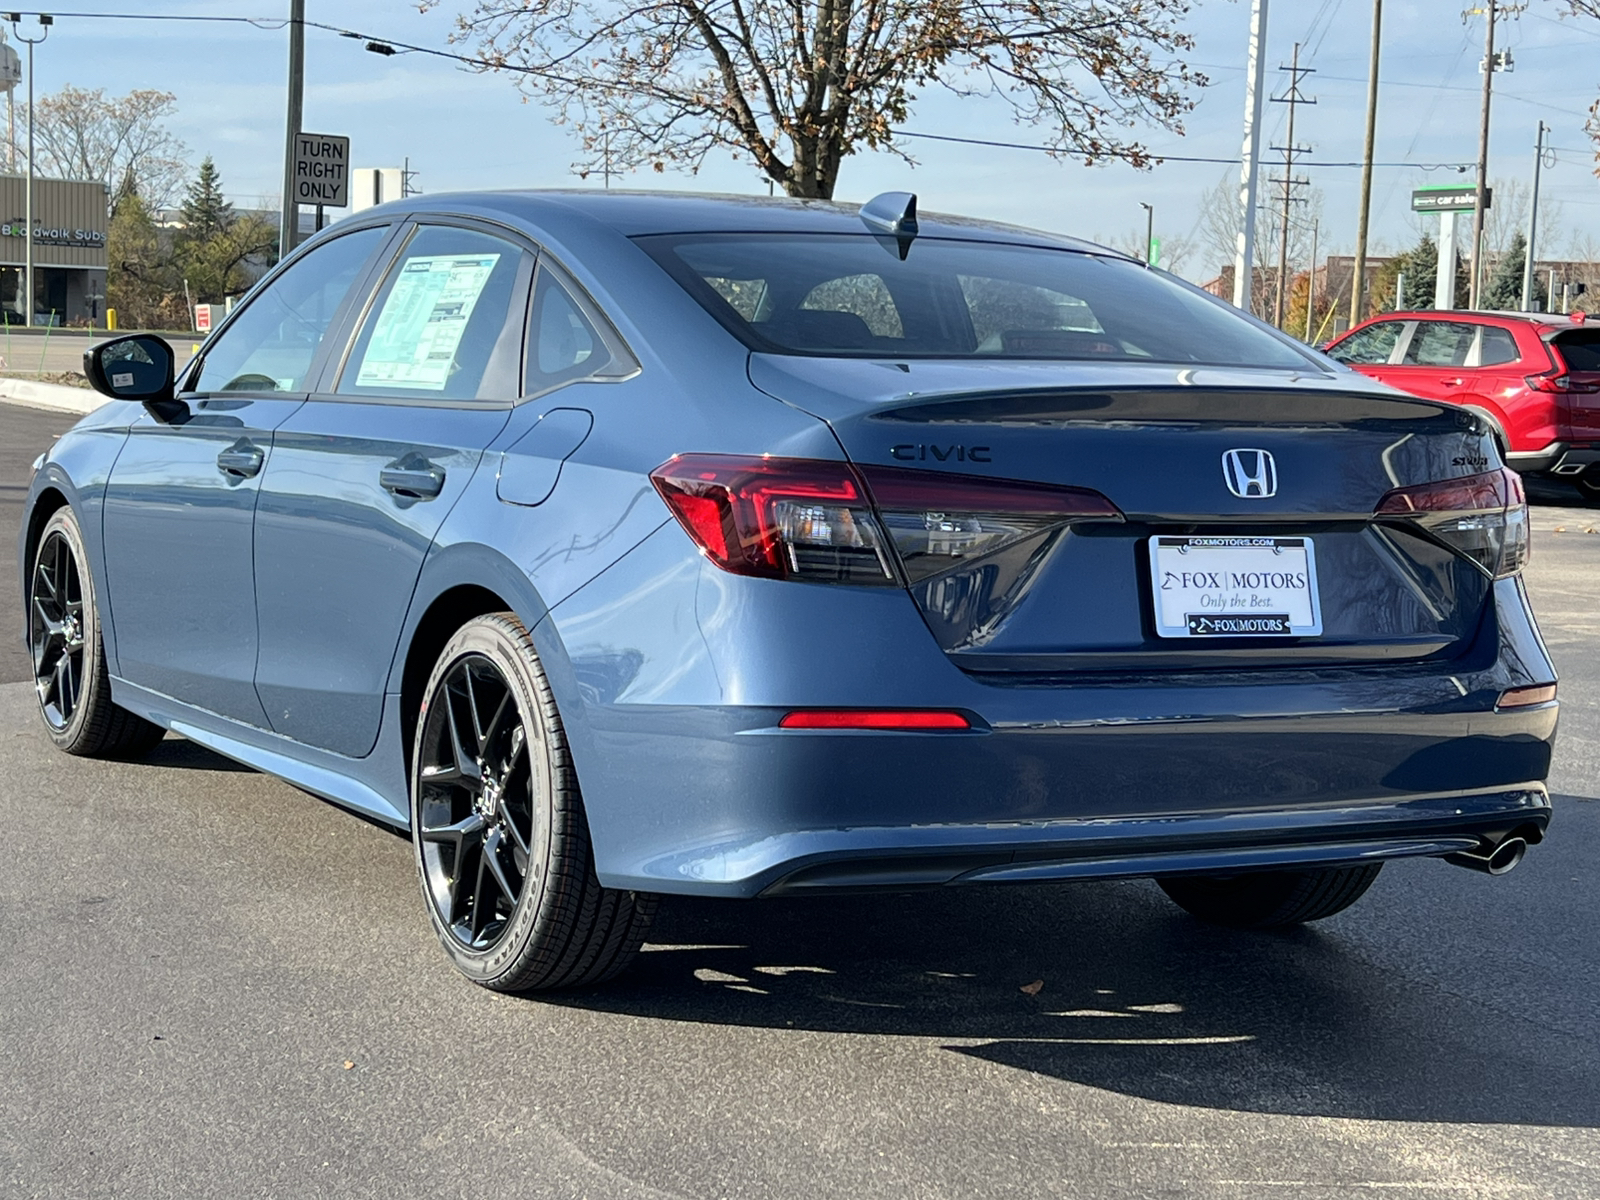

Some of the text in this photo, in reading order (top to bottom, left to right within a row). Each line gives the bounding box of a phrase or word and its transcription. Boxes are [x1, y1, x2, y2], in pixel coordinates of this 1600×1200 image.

[301, 140, 343, 159] TURN
[298, 160, 345, 180] RIGHT
[300, 181, 341, 200] ONLY
[1437, 195, 1453, 205] car
[1, 224, 107, 242] Boadwalk Subs
[889, 444, 992, 463] CIVIC
[1188, 538, 1275, 546] FOXMOTORS.COM
[1181, 572, 1305, 590] FOX MOTORS
[1200, 593, 1273, 612] Only the Best.
